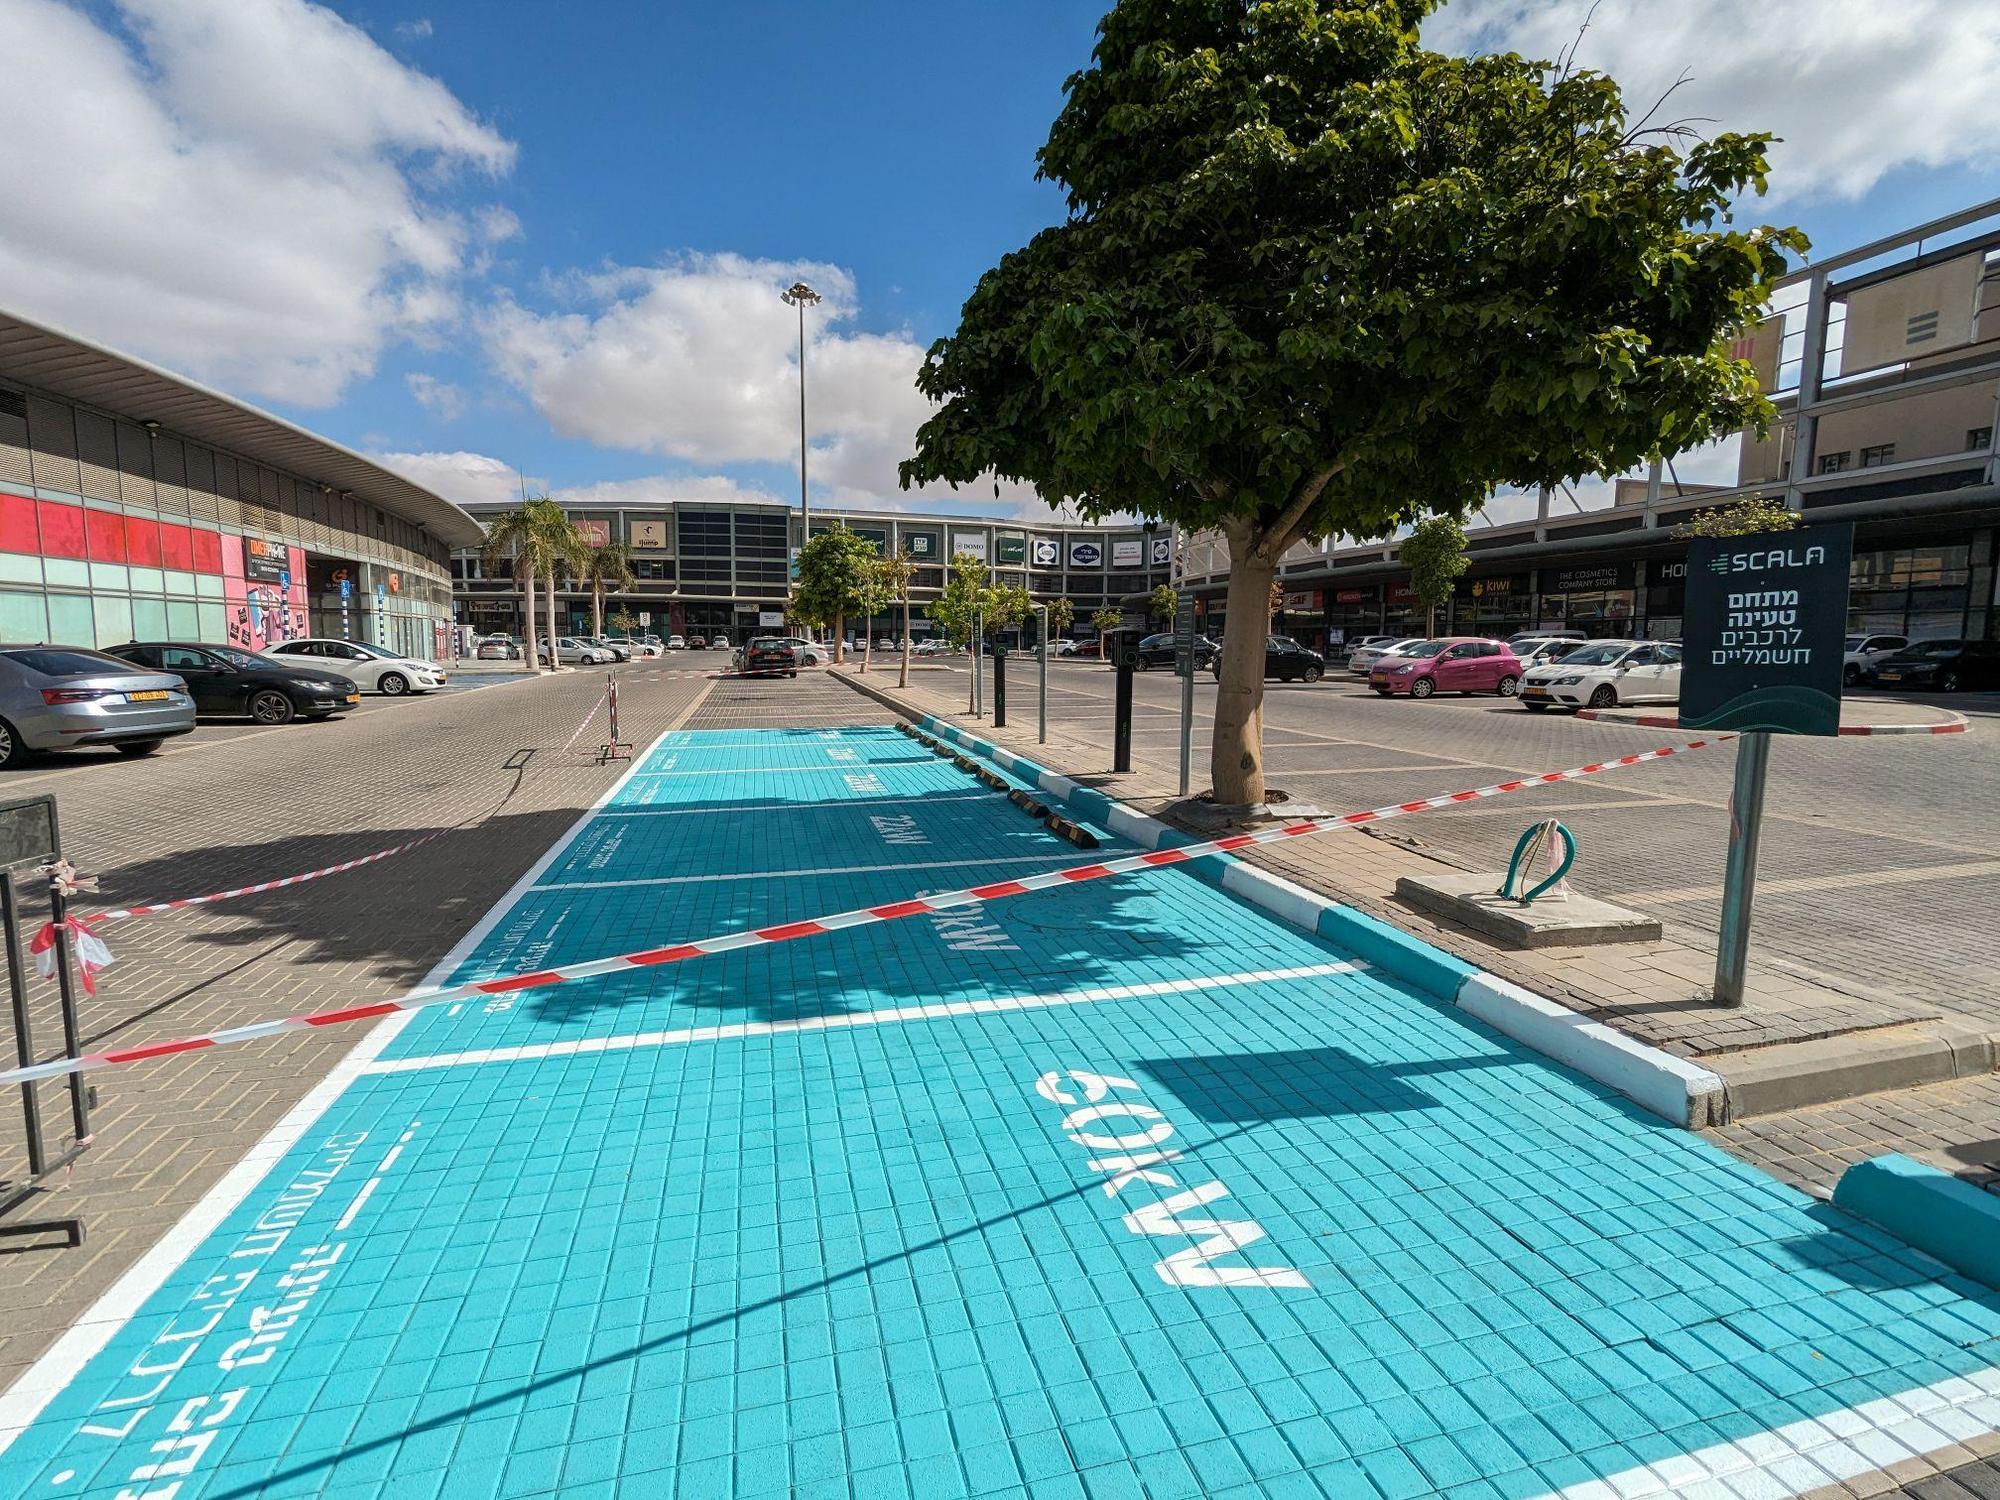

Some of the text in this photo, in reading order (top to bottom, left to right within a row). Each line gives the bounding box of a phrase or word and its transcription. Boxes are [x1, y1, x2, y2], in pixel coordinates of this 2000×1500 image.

[1732, 546, 1825, 572] SCALA
[1558, 577, 1618, 589] COMPANY STORE
[1559, 568, 1619, 580] THE COSMETICS
[1486, 579, 1511, 591] KIWI
[1728, 590, 1799, 609] מתחם
[1728, 609, 1797, 627] טעינה
[1721, 627, 1803, 646] לרכבים
[1711, 647, 1811, 665] חשמליים
[869, 814, 933, 844] 22kW
[1035, 1069, 1313, 1289] 60kW
[79, 1131, 369, 1438] לרכבים חשמליים
[217, 1242, 348, 1371] טעינה
